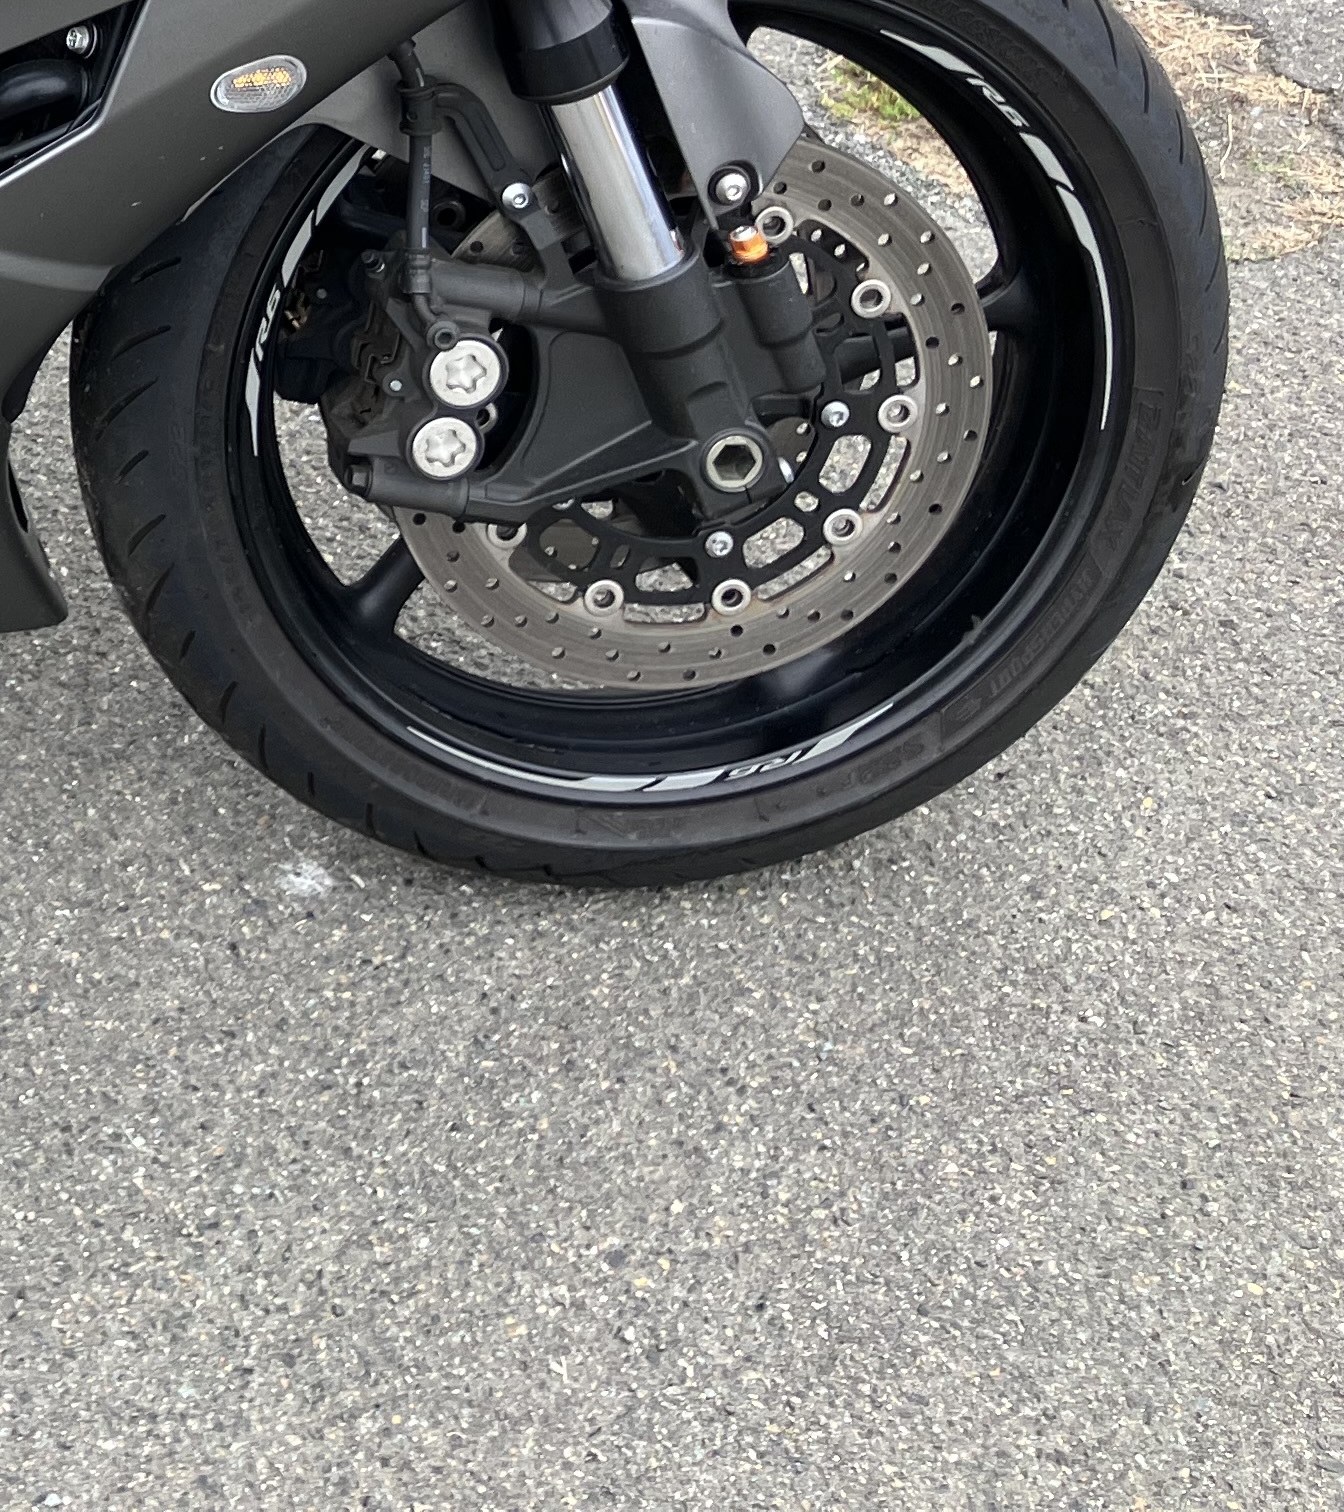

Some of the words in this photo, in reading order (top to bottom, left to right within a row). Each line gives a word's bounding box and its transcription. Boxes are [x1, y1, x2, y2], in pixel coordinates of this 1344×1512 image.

[965, 76, 1031, 129] R6
[255, 280, 282, 363] R6
[725, 749, 803, 781] R6
